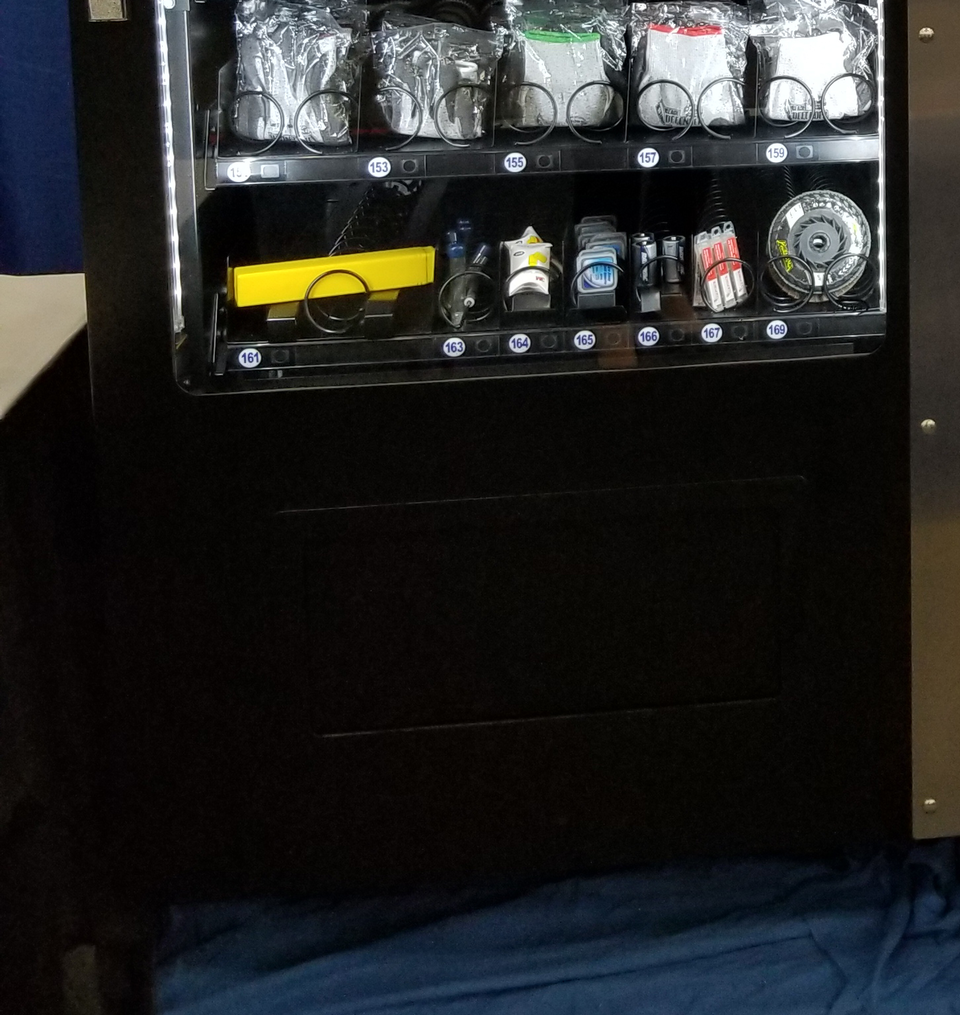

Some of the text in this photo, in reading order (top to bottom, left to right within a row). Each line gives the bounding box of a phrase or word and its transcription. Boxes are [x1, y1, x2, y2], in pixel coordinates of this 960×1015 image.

[639, 152, 656, 163] 157
[767, 148, 784, 159] 159
[369, 162, 388, 173] 153
[505, 157, 524, 168] 155
[703, 327, 720, 338] 167
[768, 325, 785, 336] 169
[575, 334, 593, 345] 165
[639, 331, 657, 342] 166
[444, 342, 463, 353] 163
[510, 337, 528, 348] 164
[241, 352, 259, 363] 161
